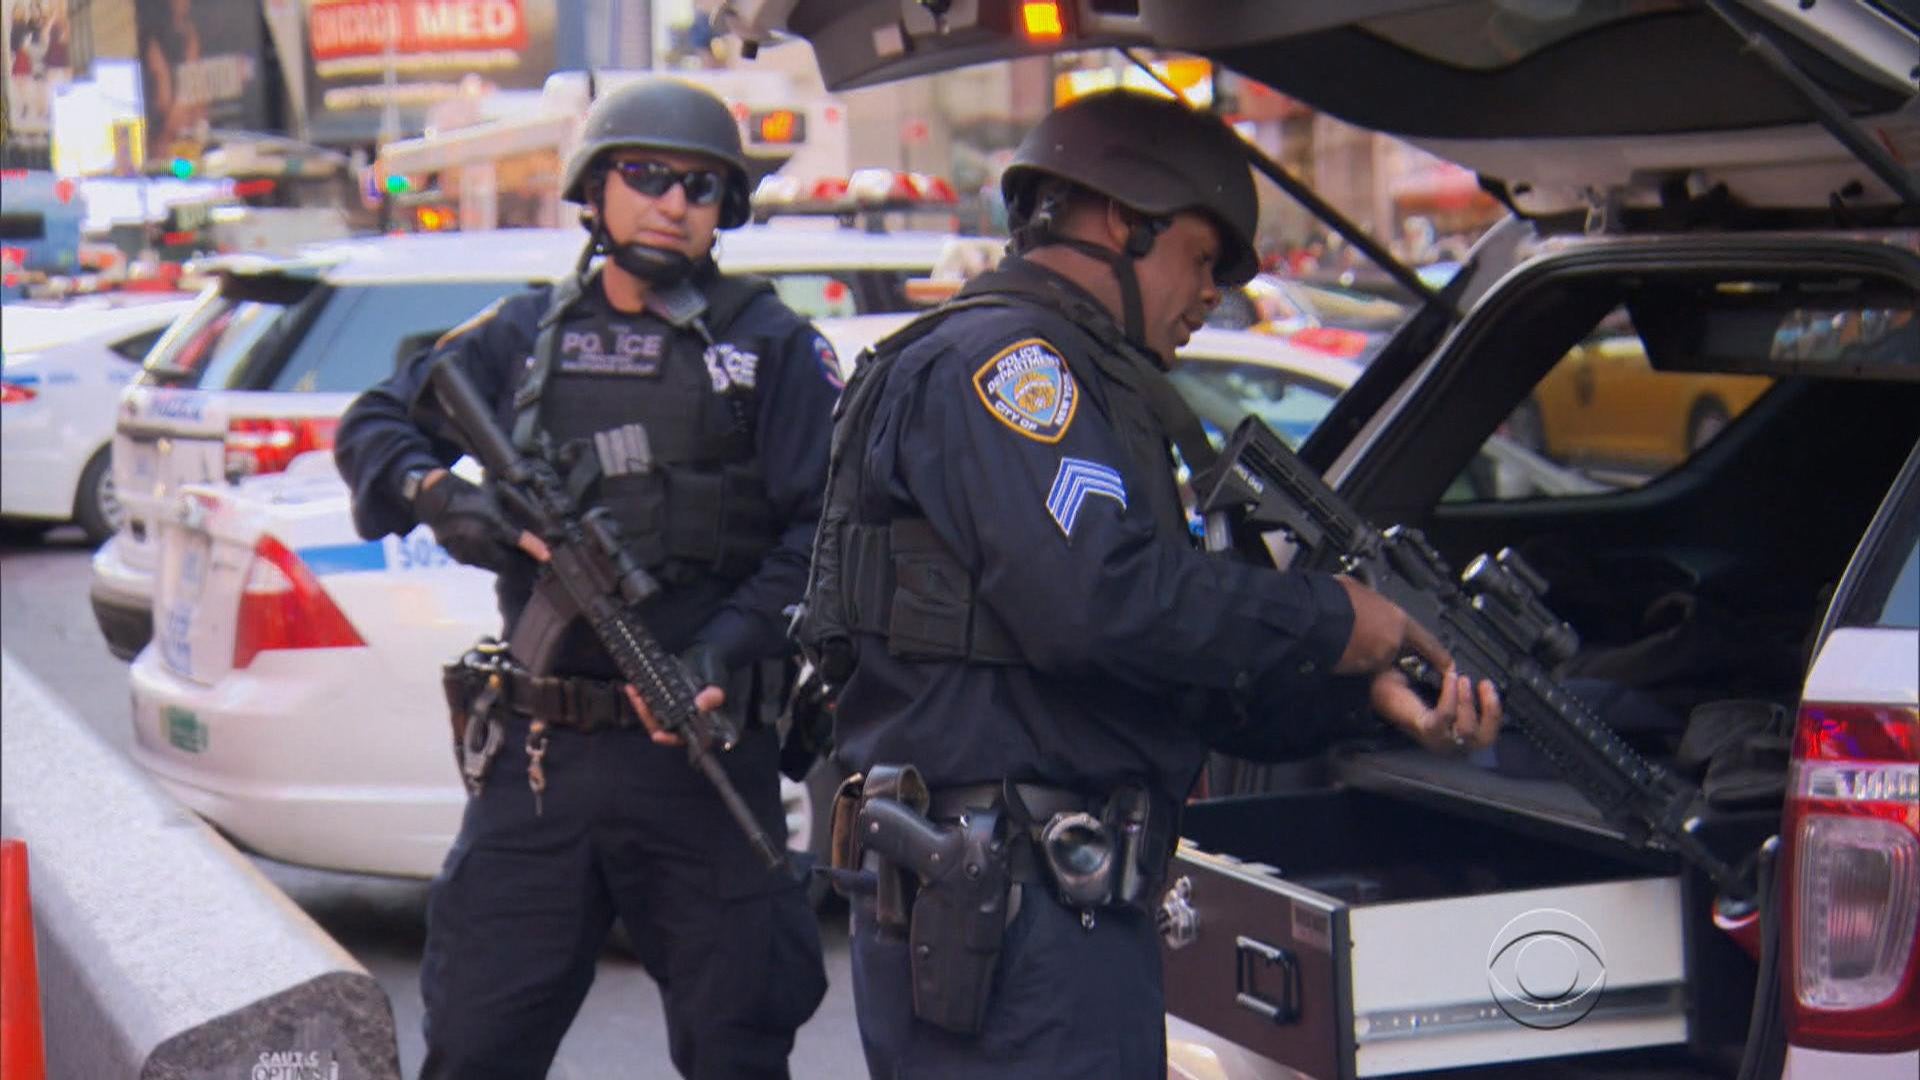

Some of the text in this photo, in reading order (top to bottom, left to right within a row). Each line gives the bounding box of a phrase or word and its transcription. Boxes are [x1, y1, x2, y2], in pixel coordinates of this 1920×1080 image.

[414, 0, 519, 37] MED
[561, 331, 662, 356] POICE
[996, 345, 1041, 373] POLICE
